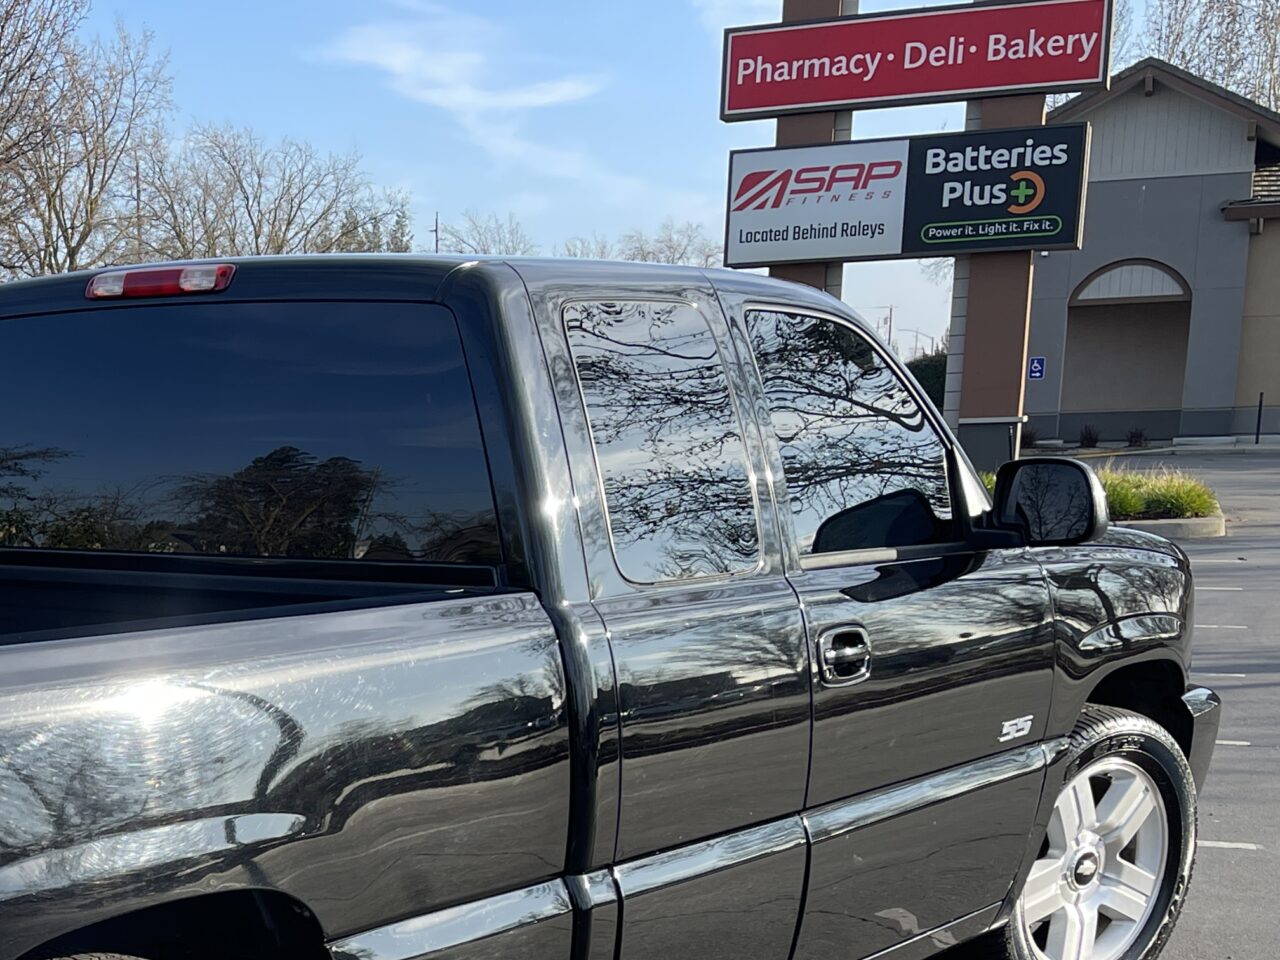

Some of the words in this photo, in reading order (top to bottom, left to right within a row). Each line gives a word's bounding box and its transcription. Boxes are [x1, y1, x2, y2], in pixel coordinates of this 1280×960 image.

[986, 29, 1099, 62] Bakery
[925, 138, 1068, 175] Batteries
[785, 190, 892, 206] FITNESS
[739, 225, 789, 244] Located
[792, 222, 838, 241] Behind
[841, 220, 885, 239] Raleys
[928, 226, 962, 238] Power
[964, 225, 976, 235] it.
[978, 223, 1007, 236] Light
[1009, 222, 1020, 232] it.
[1023, 221, 1039, 231] Fix
[1041, 220, 1054, 230] it.
